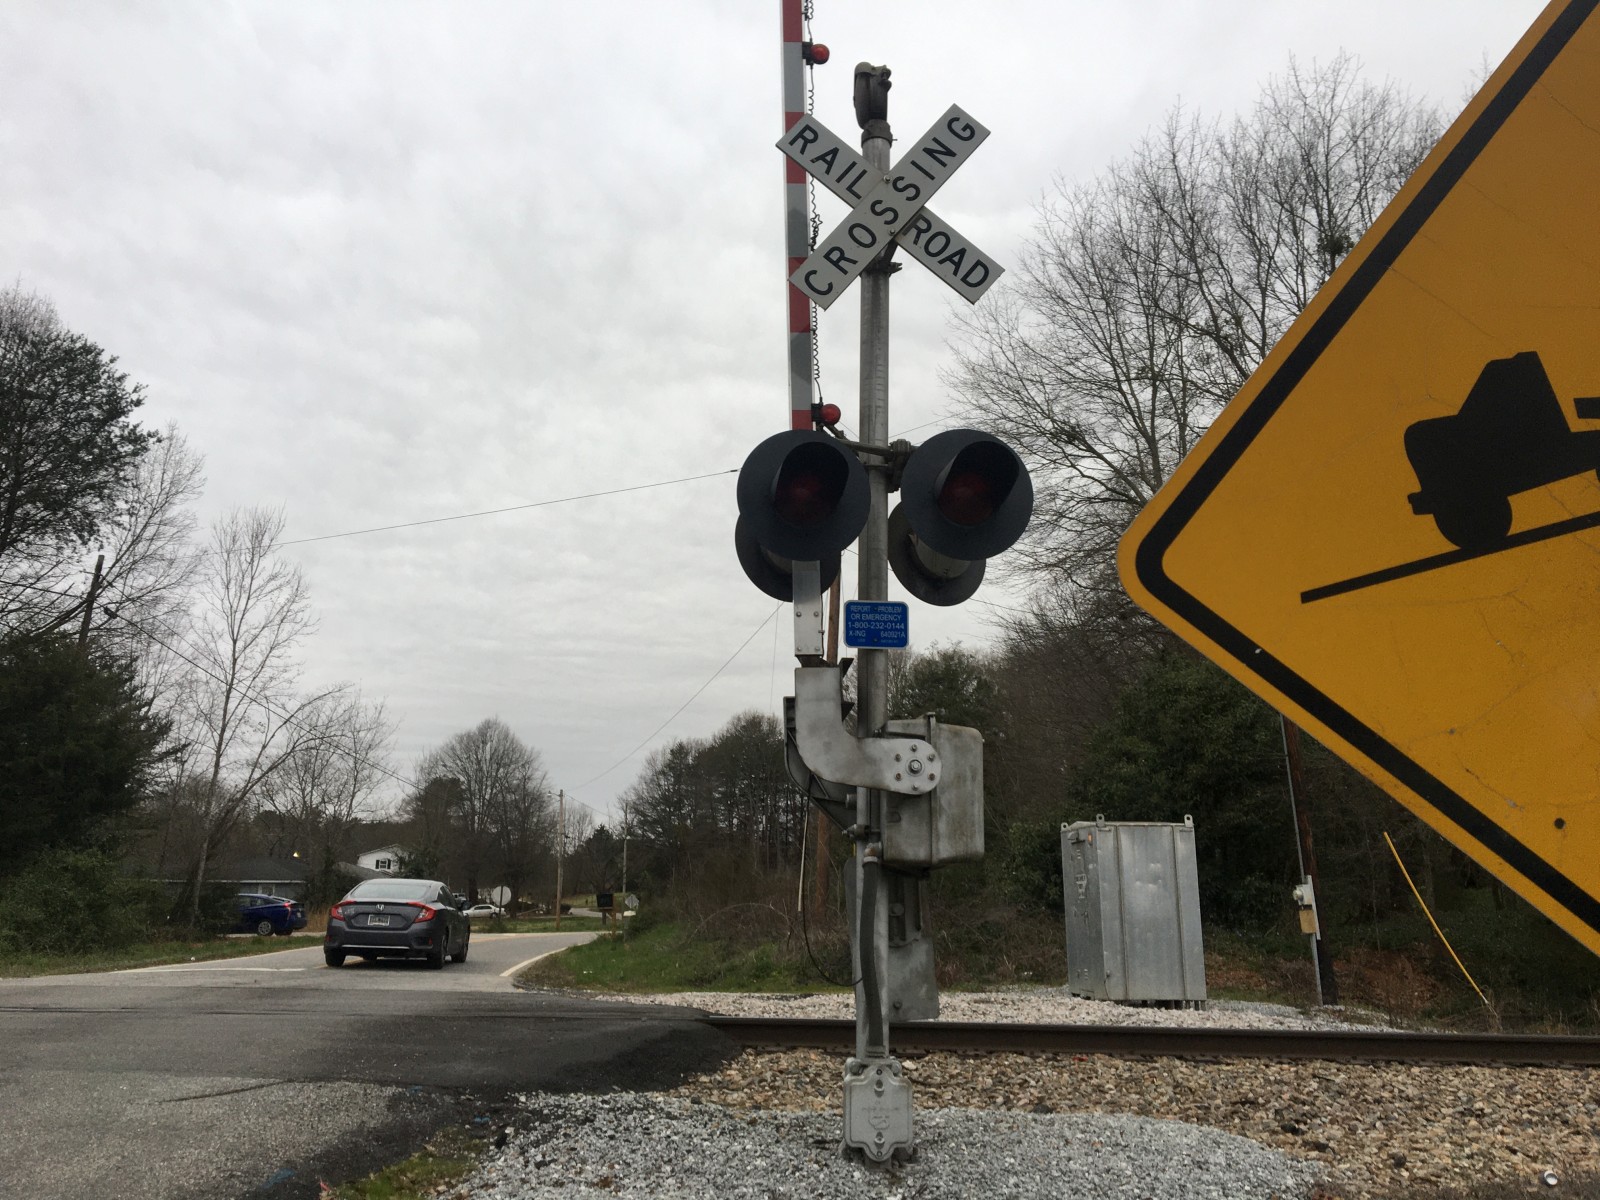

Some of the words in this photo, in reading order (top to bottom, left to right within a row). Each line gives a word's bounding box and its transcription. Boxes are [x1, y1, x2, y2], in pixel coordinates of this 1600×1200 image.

[788, 123, 868, 200] RAIL
[901, 213, 990, 288] ROAD
[804, 116, 976, 297] CROSSING
[848, 621, 905, 629] 1-800-232-0144
[862, 613, 902, 621] EMERGENCY
